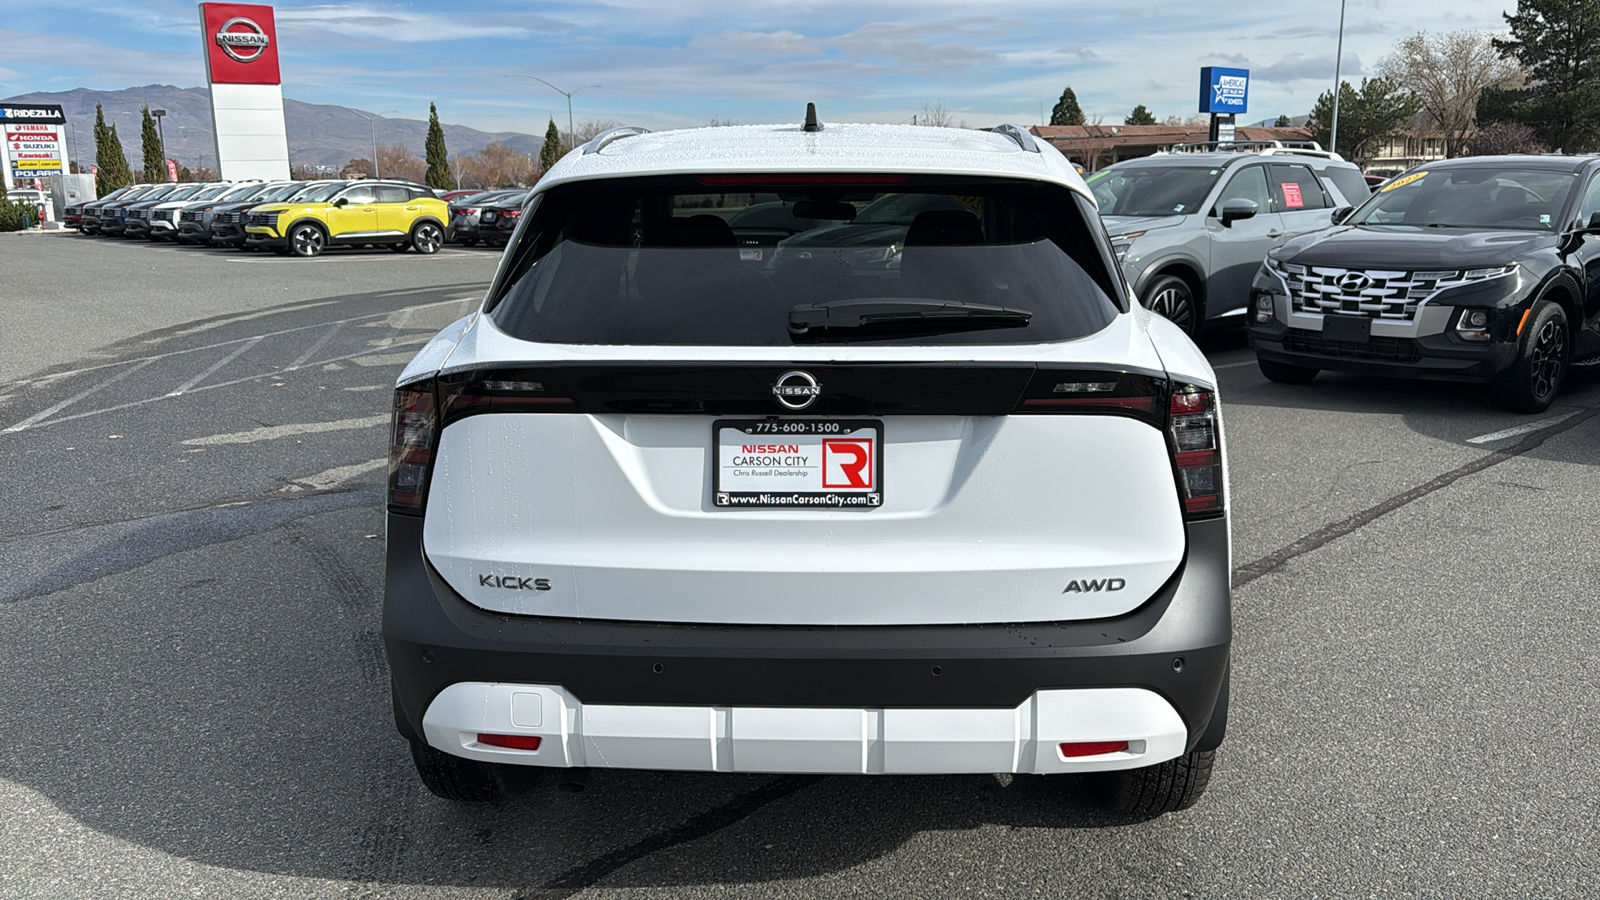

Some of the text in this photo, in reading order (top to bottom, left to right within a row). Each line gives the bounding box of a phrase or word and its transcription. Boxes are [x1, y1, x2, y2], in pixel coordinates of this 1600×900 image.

[222, 35, 265, 44] NISSAN
[14, 110, 61, 118] RIDEZILLA
[772, 386, 820, 395] NISSAN
[756, 423, 840, 432] 775-600-1500
[742, 445, 799, 453] NISSAN
[732, 456, 808, 466] CARSON CITY
[751, 469, 773, 477] Russell
[774, 469, 808, 477] Dealership
[730, 494, 867, 506] www.NissanCarsonCity.com
[479, 573, 552, 591] KICKS
[1061, 578, 1126, 594] AWD
